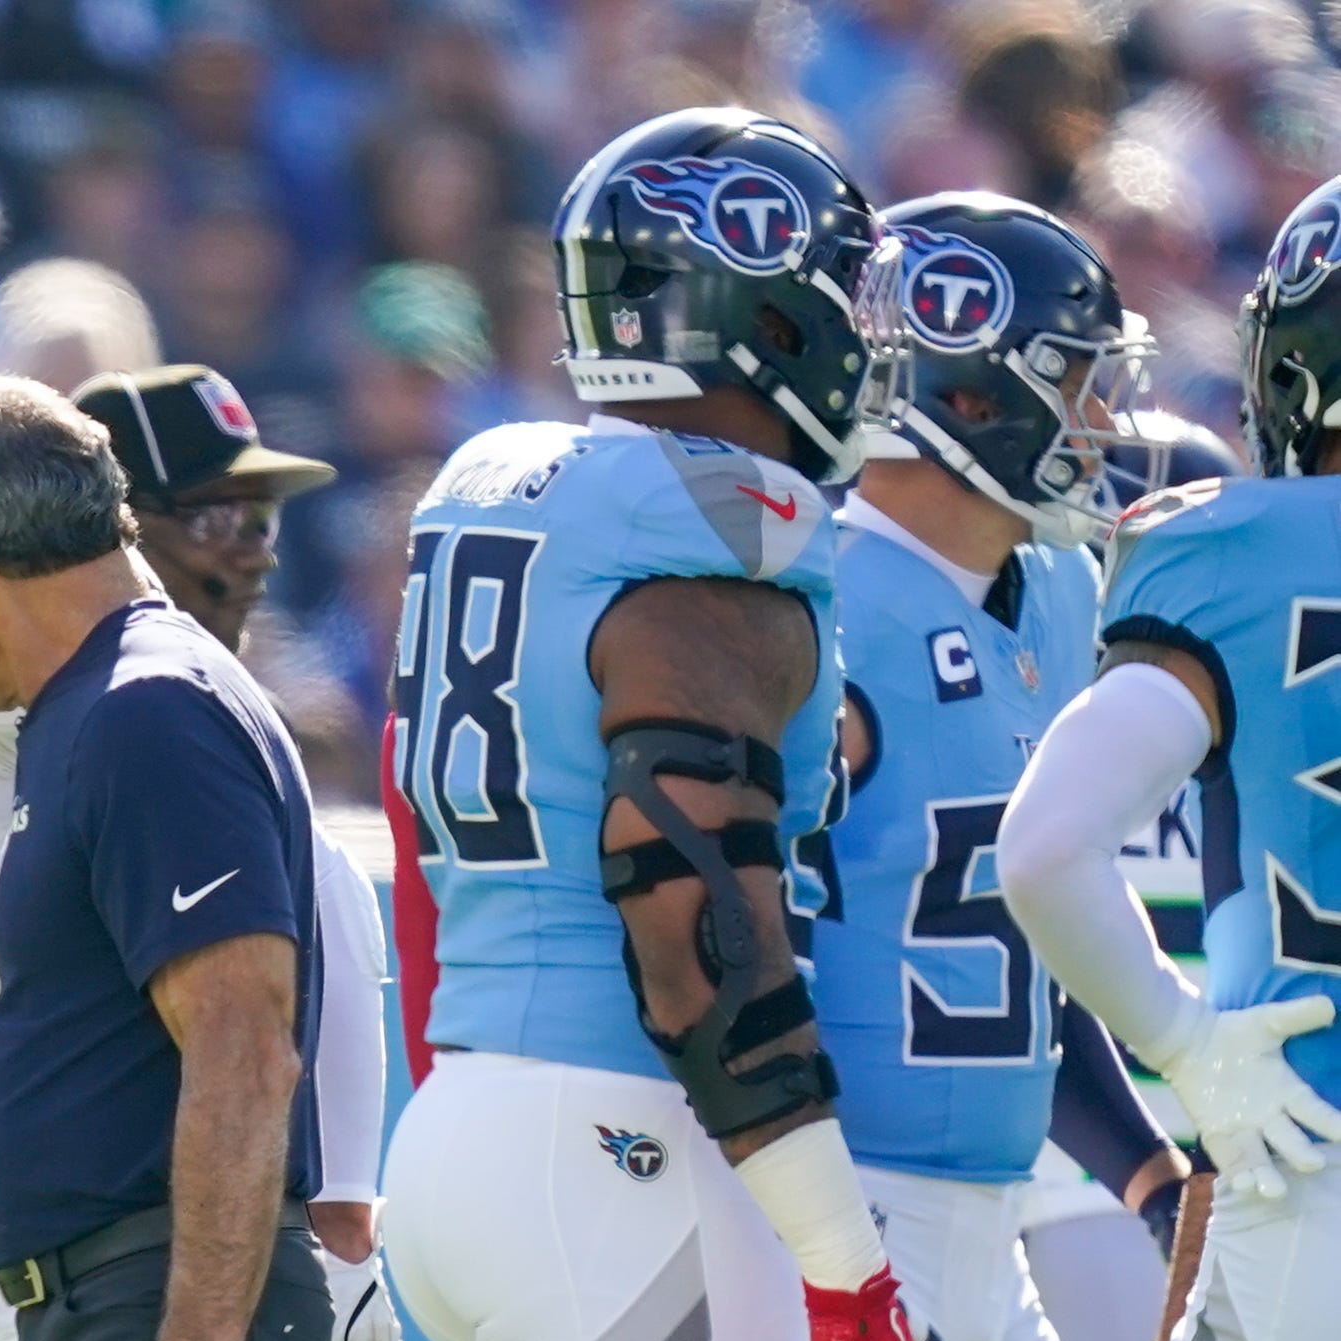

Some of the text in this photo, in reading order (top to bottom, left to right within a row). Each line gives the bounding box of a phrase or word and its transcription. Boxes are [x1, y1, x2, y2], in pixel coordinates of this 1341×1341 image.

[720, 197, 787, 256] T
[1286, 220, 1336, 280] T
[922, 271, 993, 332] T
[933, 630, 976, 683] C
[901, 791, 1066, 1067] 5
